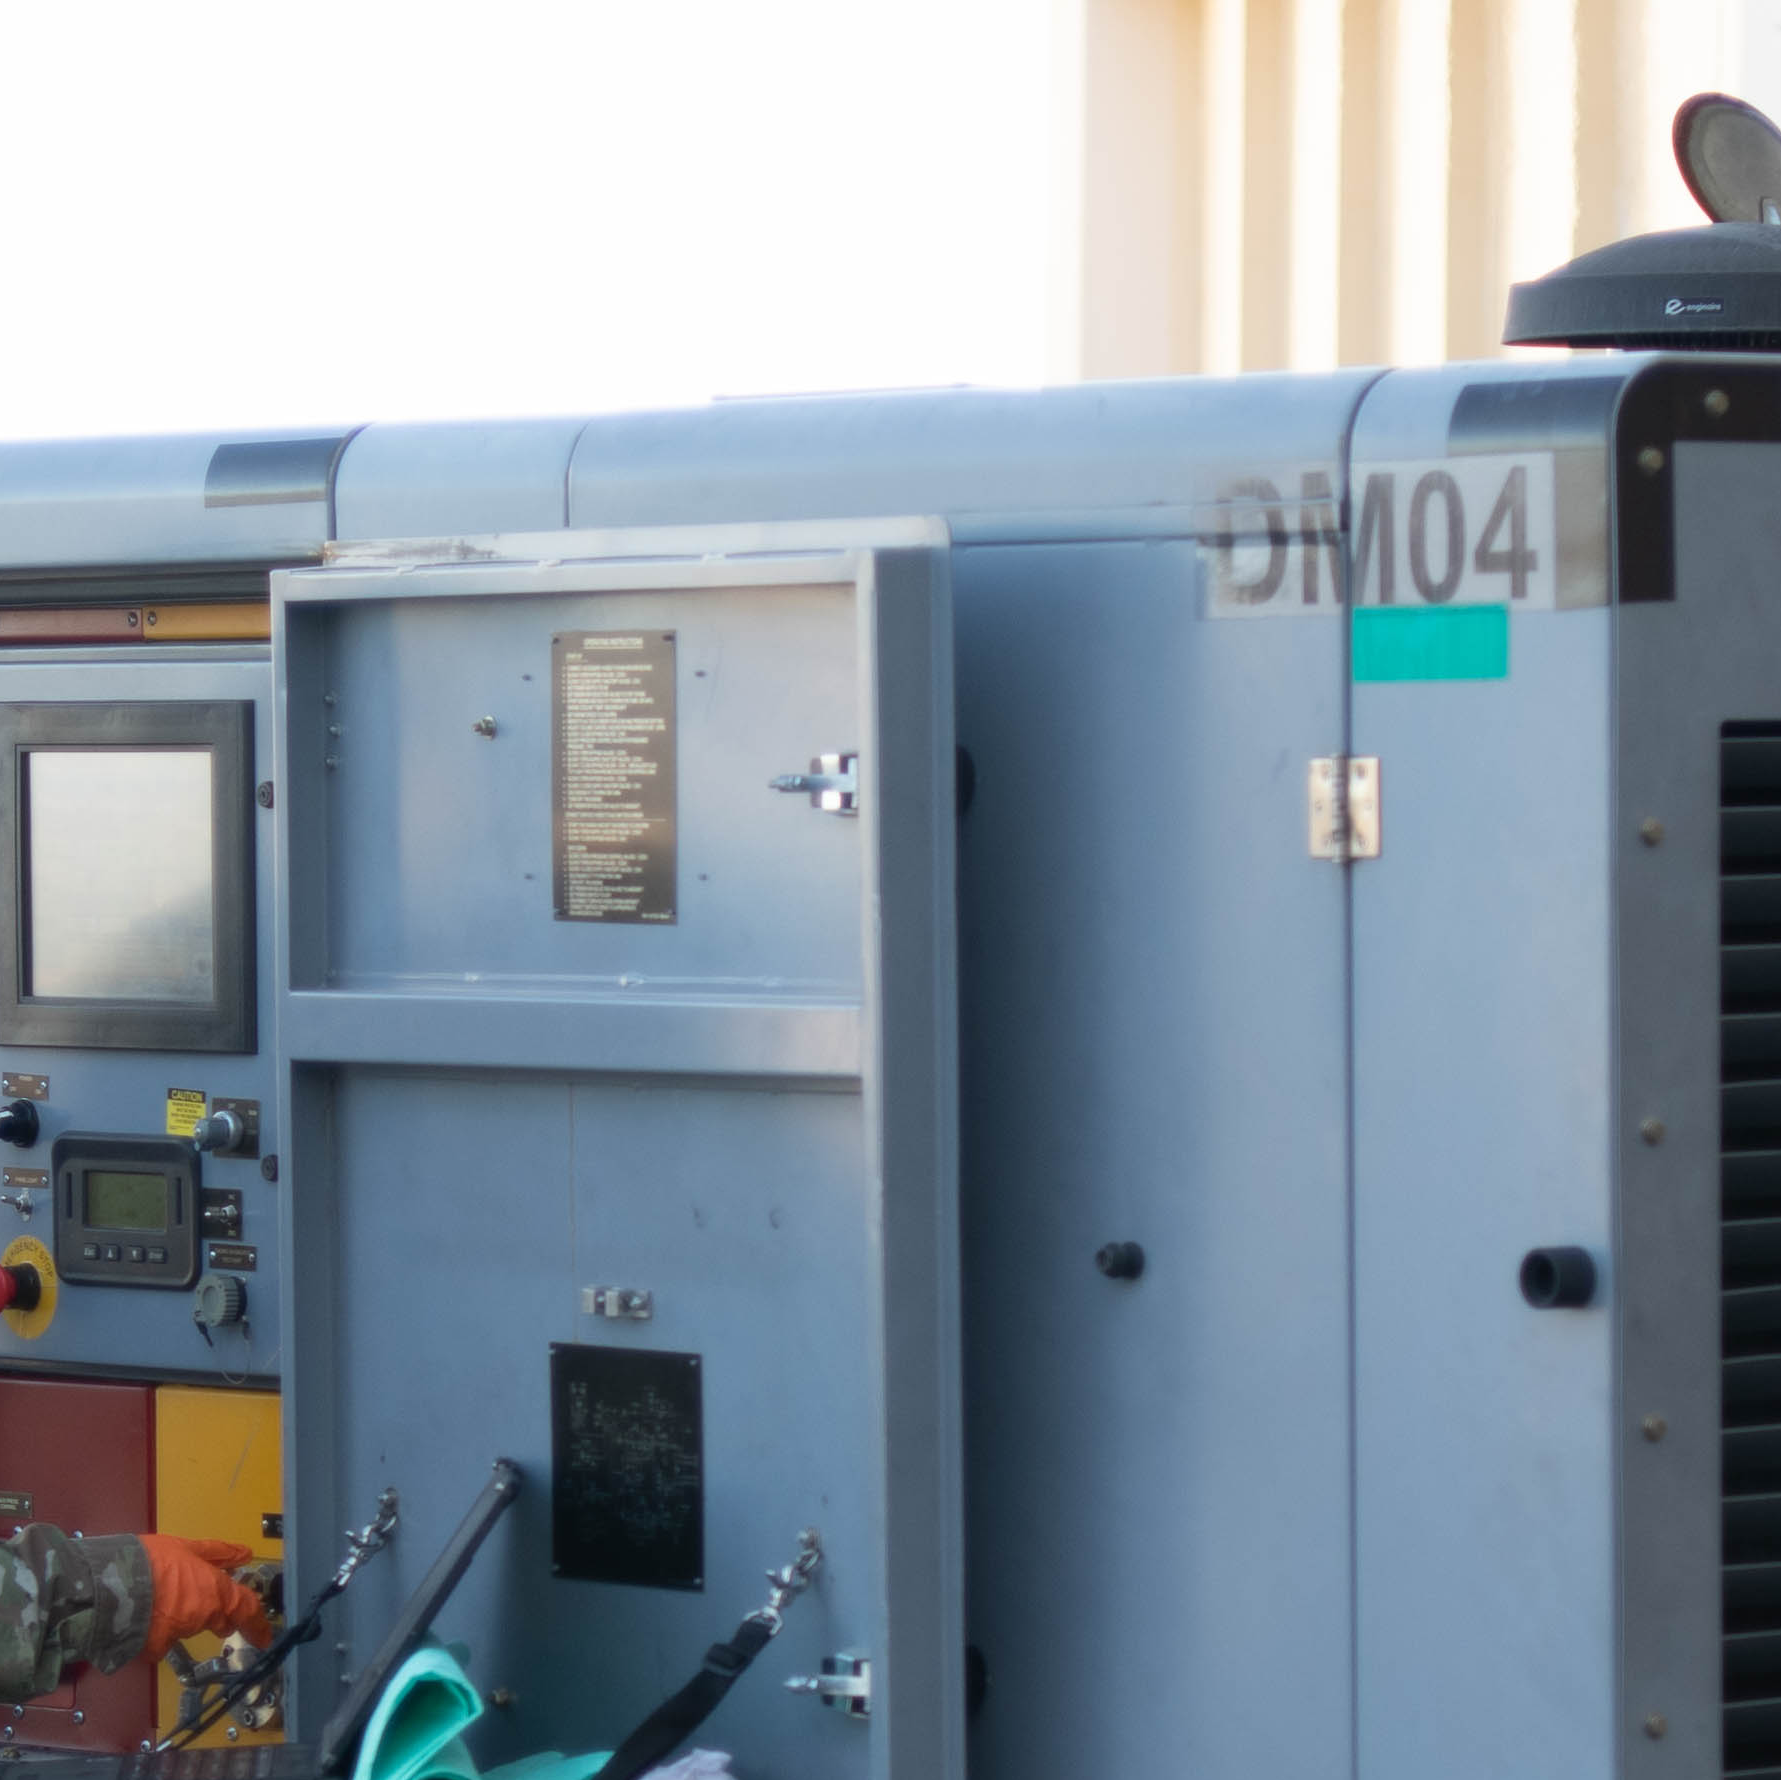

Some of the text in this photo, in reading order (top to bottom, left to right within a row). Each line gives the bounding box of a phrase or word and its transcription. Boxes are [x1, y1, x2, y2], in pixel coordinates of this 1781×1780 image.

[1214, 466, 1538, 606] DM04
[171, 1089, 203, 1102] CAUTION
[38, 1250, 53, 1278] STOP
